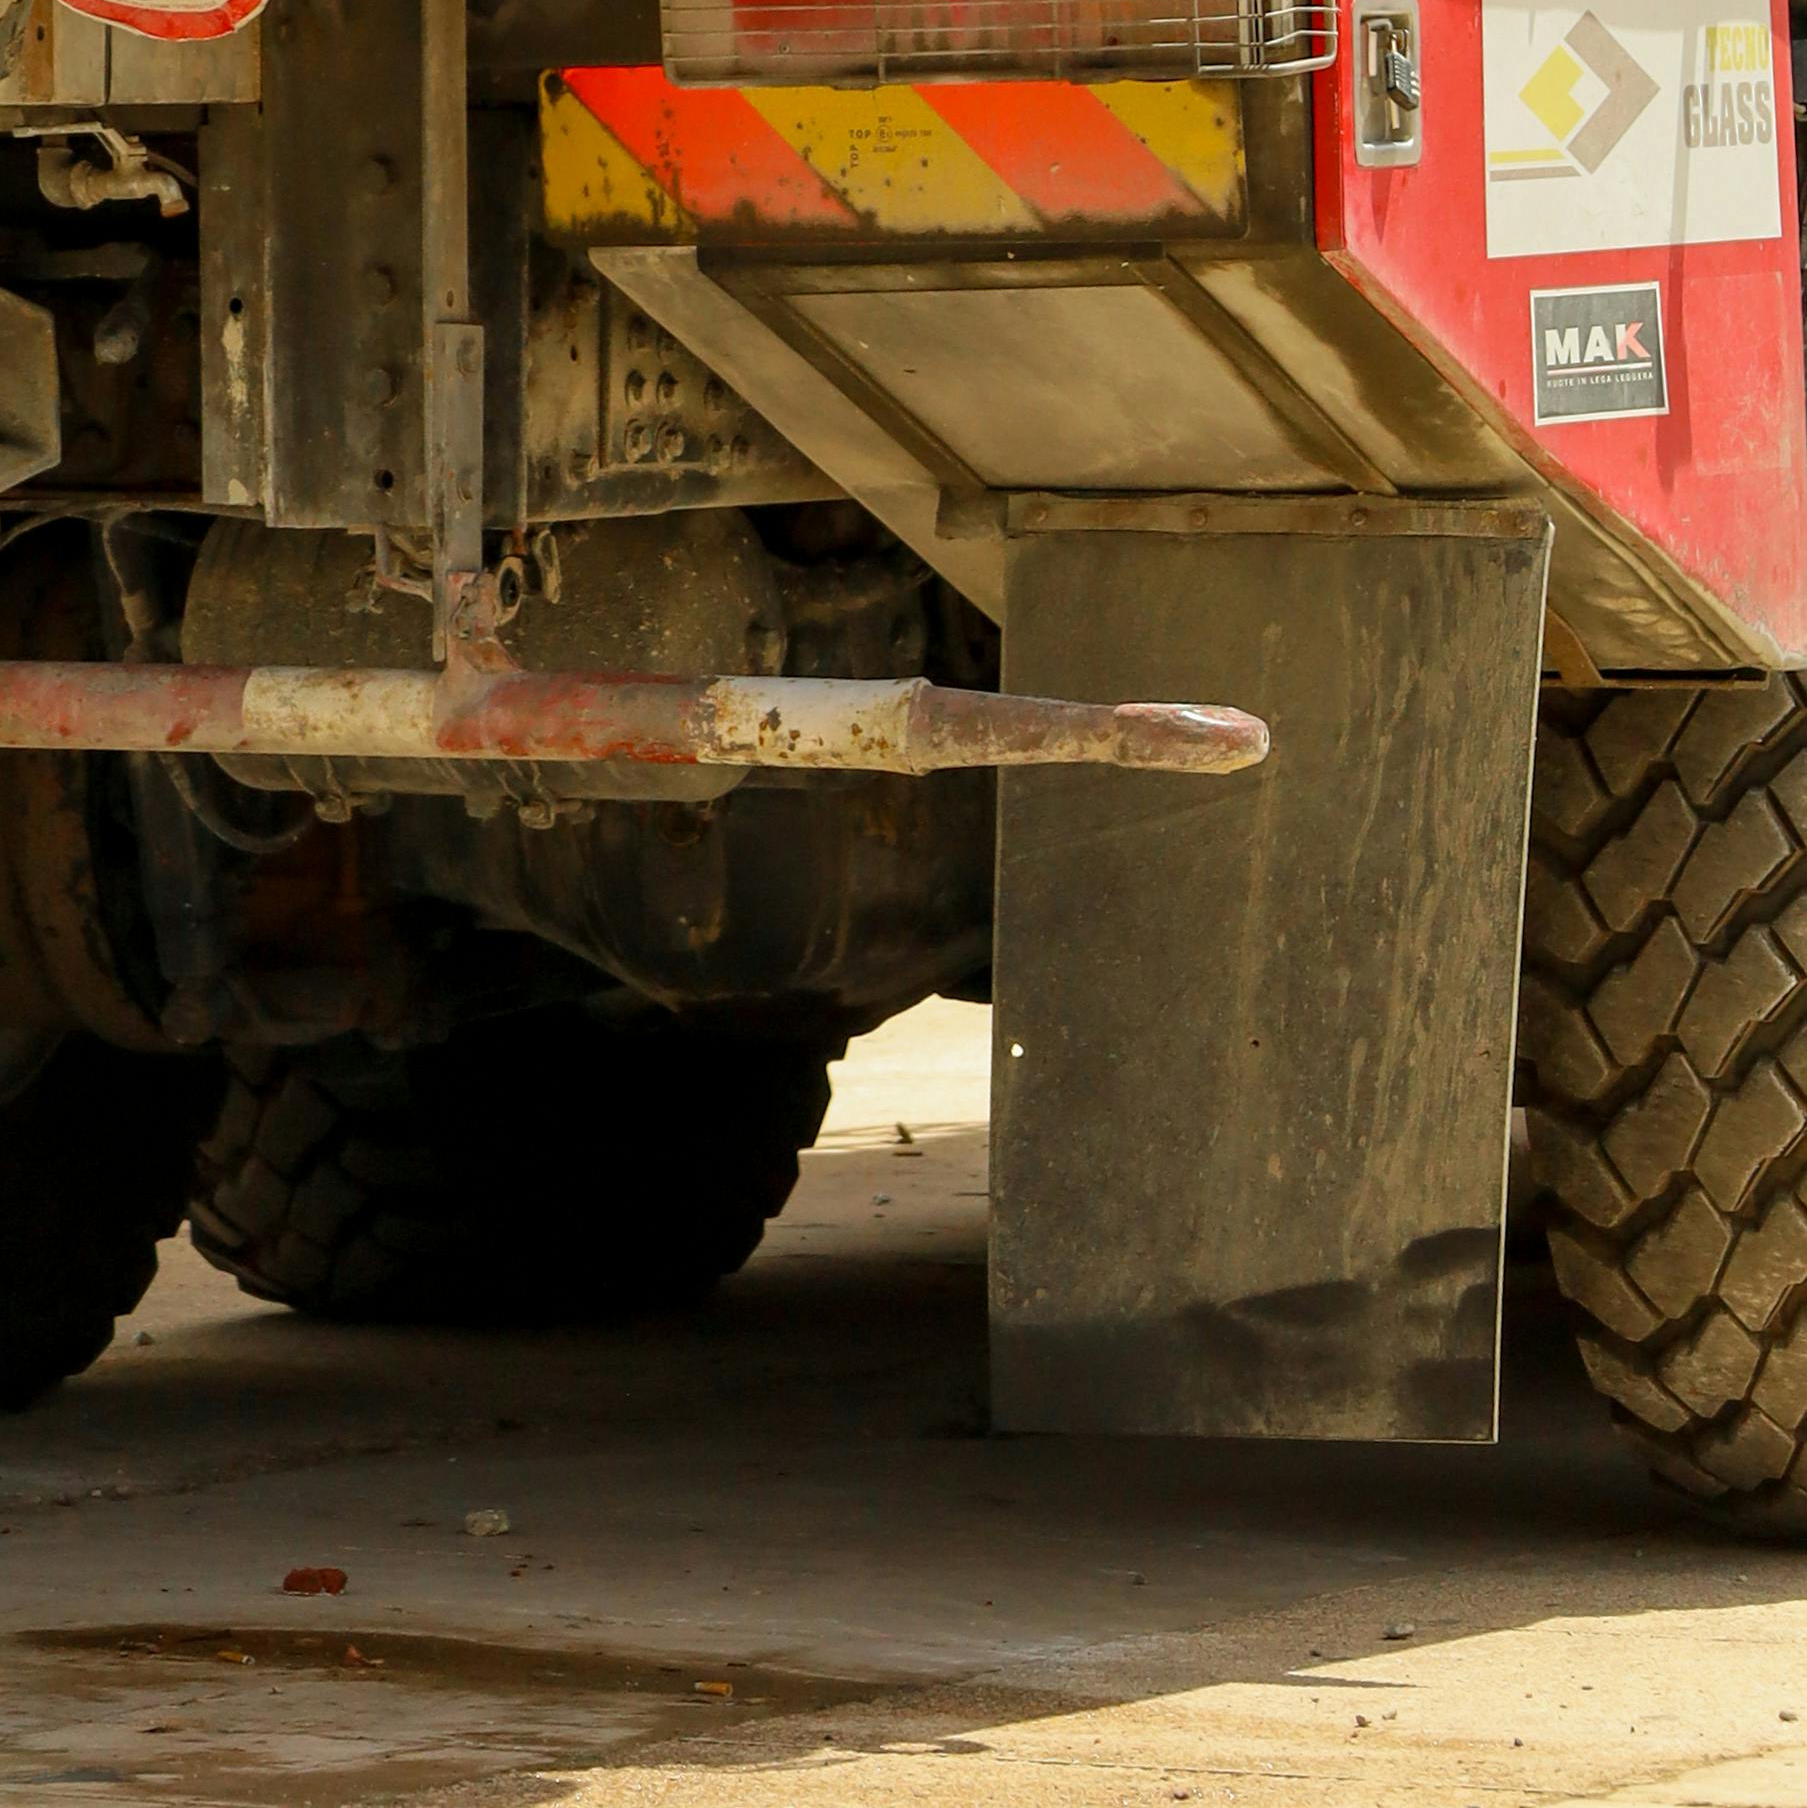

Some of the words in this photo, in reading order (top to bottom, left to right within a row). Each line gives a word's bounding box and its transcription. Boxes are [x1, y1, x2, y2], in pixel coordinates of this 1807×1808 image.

[1706, 25, 1769, 73] TECNO
[849, 129, 871, 139] TOP
[1683, 81, 1772, 148] GLASS
[1545, 322, 1652, 366] MAK
